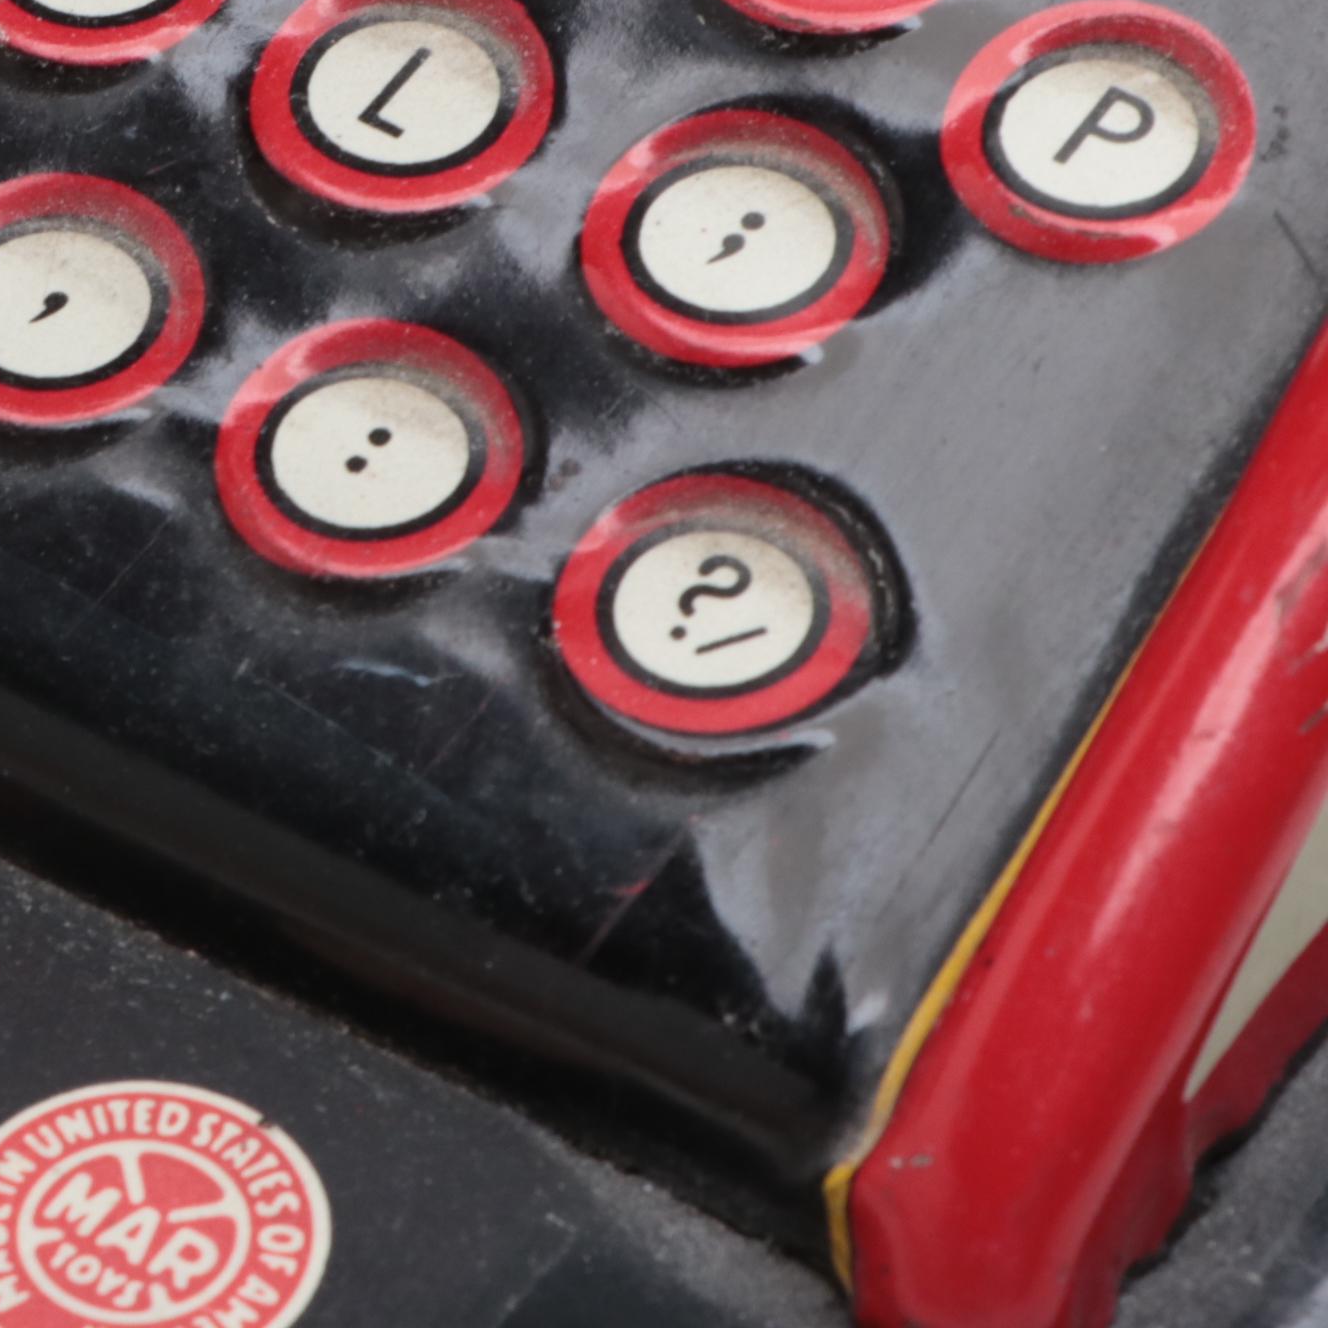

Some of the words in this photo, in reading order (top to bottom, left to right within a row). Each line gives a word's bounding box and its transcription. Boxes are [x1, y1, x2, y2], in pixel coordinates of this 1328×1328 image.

[357, 47, 432, 139] L
[1052, 85, 1156, 165] P
[706, 212, 766, 264] ;
[29, 291, 70, 324] ,
[344, 427, 392, 474] :
[23, 1098, 190, 1161] UNITED
[191, 1113, 301, 1218] STATES
[256, 1224, 306, 1276] OF
[43, 1173, 220, 1291] MAR
[49, 1242, 145, 1308] TOYS
